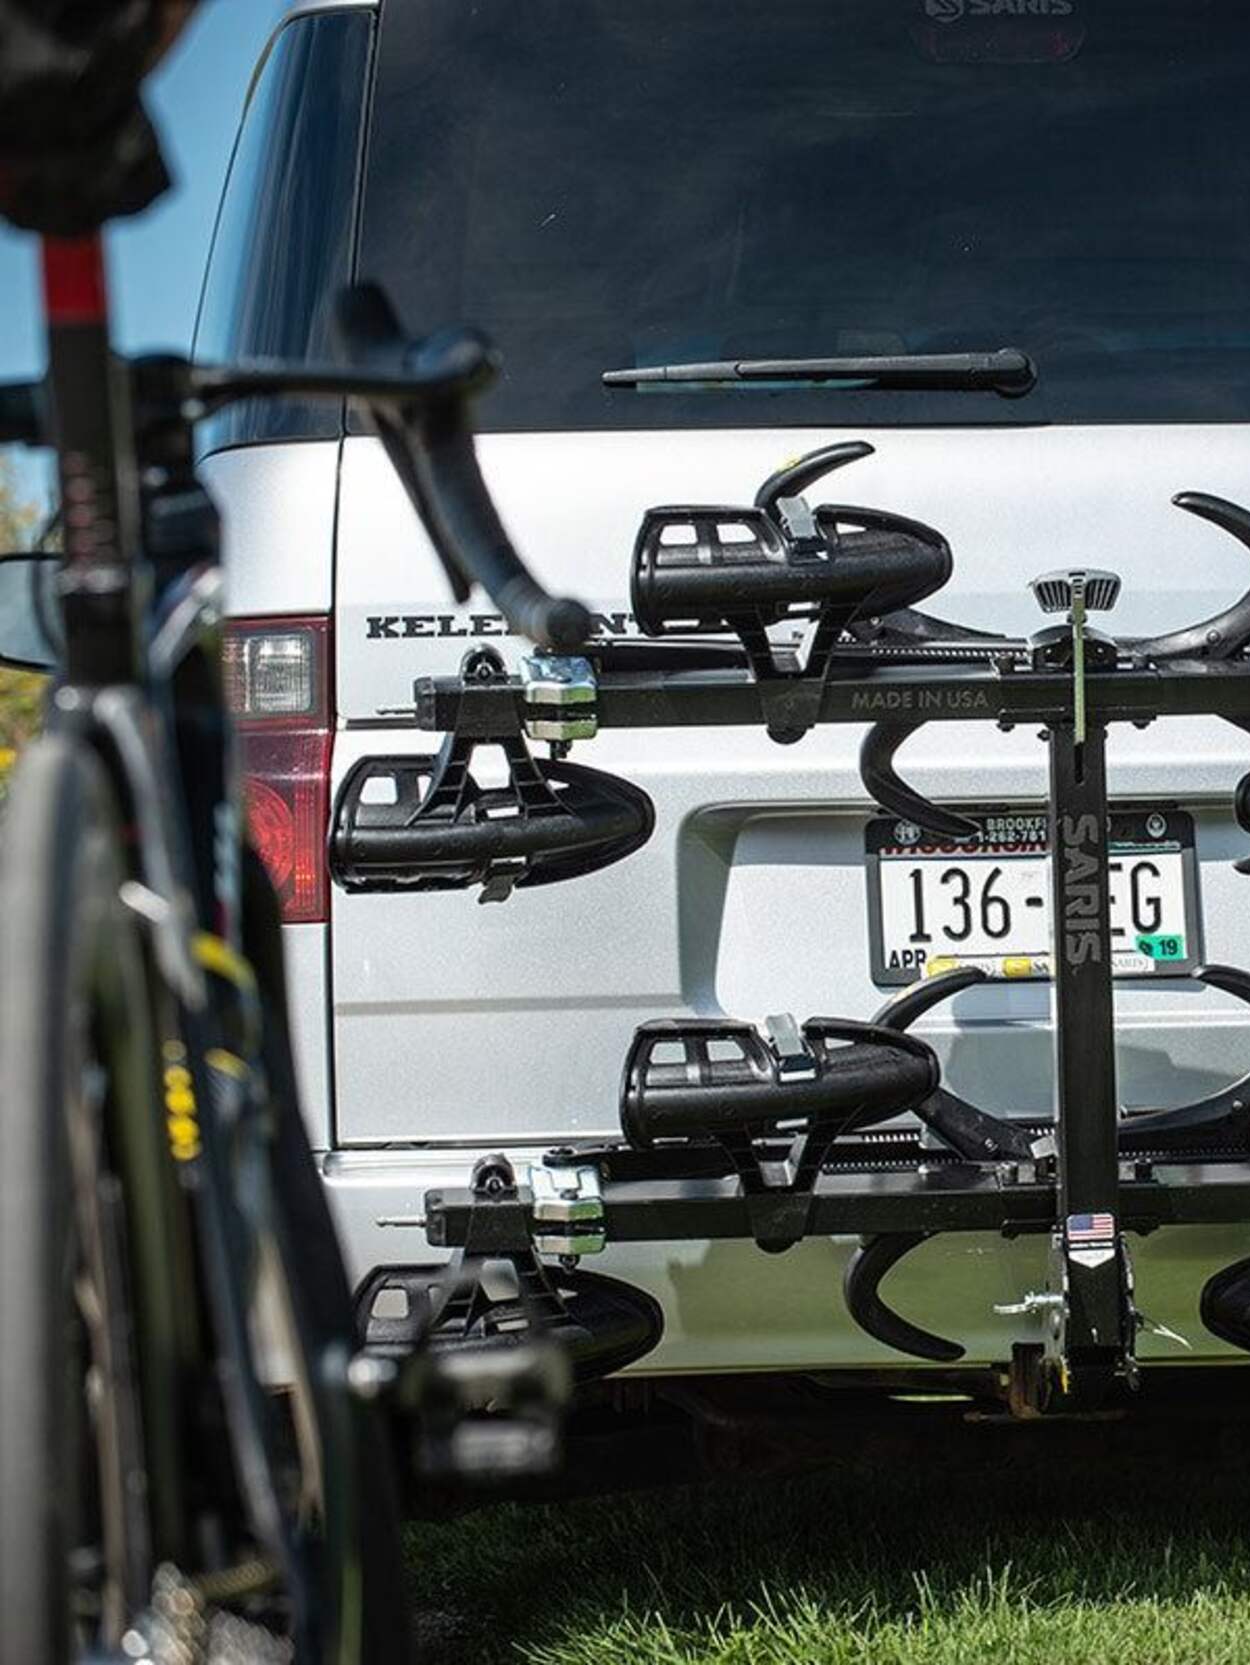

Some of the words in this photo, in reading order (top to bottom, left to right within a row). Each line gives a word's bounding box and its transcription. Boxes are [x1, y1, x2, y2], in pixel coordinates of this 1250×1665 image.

[366, 612, 640, 638] KELEN
[851, 691, 912, 709] MADE
[918, 690, 942, 708] IN
[946, 690, 989, 708] USA
[1062, 813, 1101, 965] SARIS
[1159, 938, 1179, 956] 19
[888, 949, 927, 969] APR
